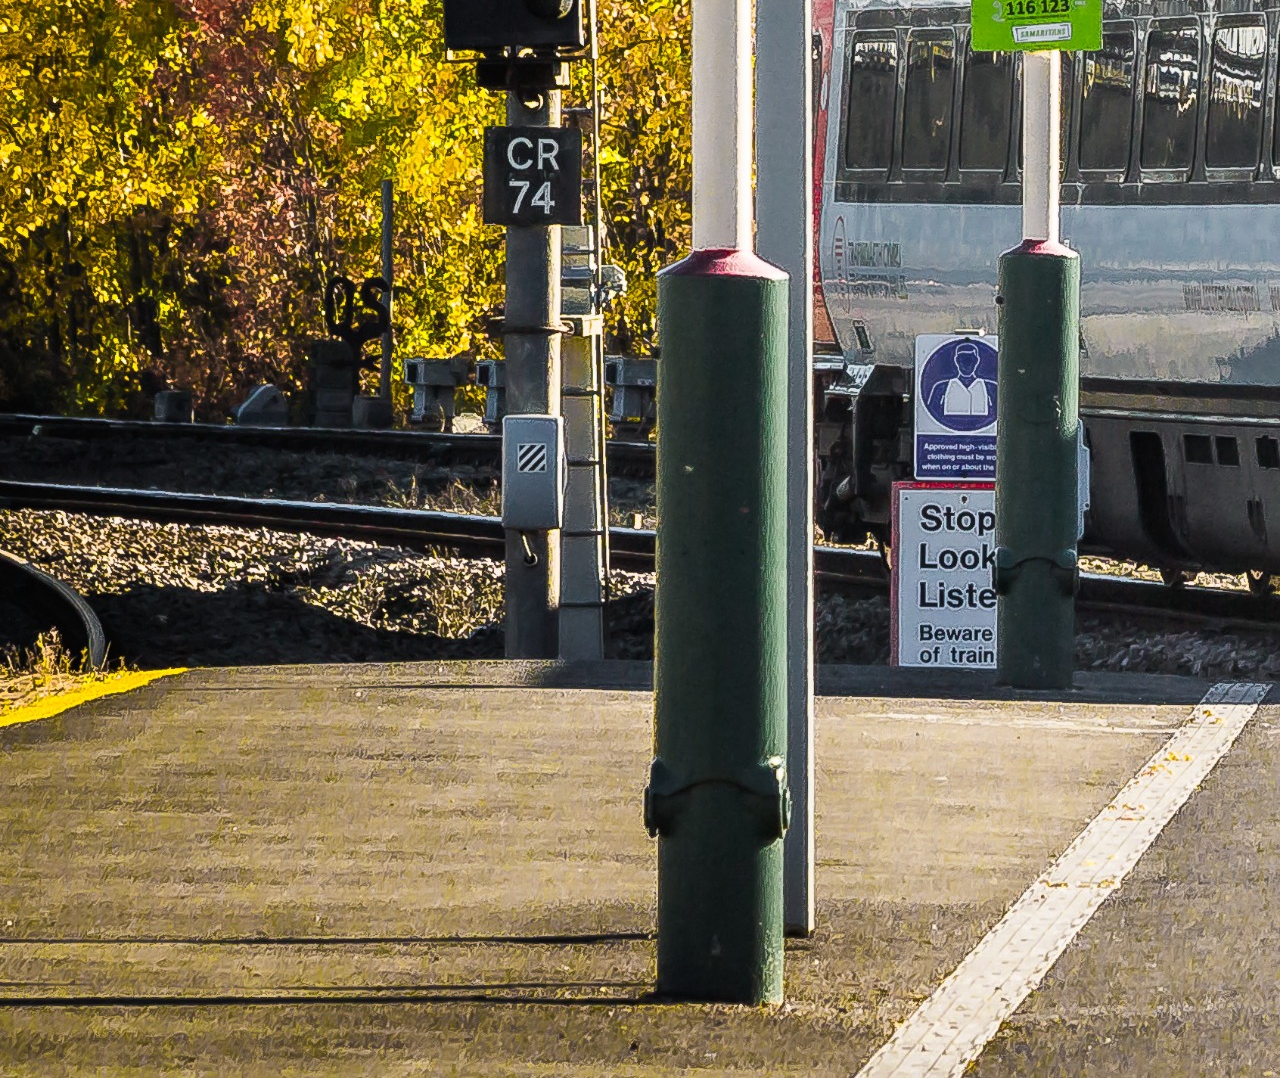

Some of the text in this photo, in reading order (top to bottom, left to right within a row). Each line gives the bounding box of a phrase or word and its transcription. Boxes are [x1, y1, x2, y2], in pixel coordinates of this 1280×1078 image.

[1006, 0, 1036, 16] 116
[1020, 27, 1066, 38] SAMARITANS
[507, 137, 559, 170] CR
[509, 180, 555, 214] 74
[923, 443, 958, 451] Approved
[961, 463, 982, 471] about
[920, 504, 996, 536] Stop
[919, 542, 996, 570] Look
[919, 582, 997, 609] Liste
[919, 624, 993, 641] Beware
[920, 646, 940, 663] of
